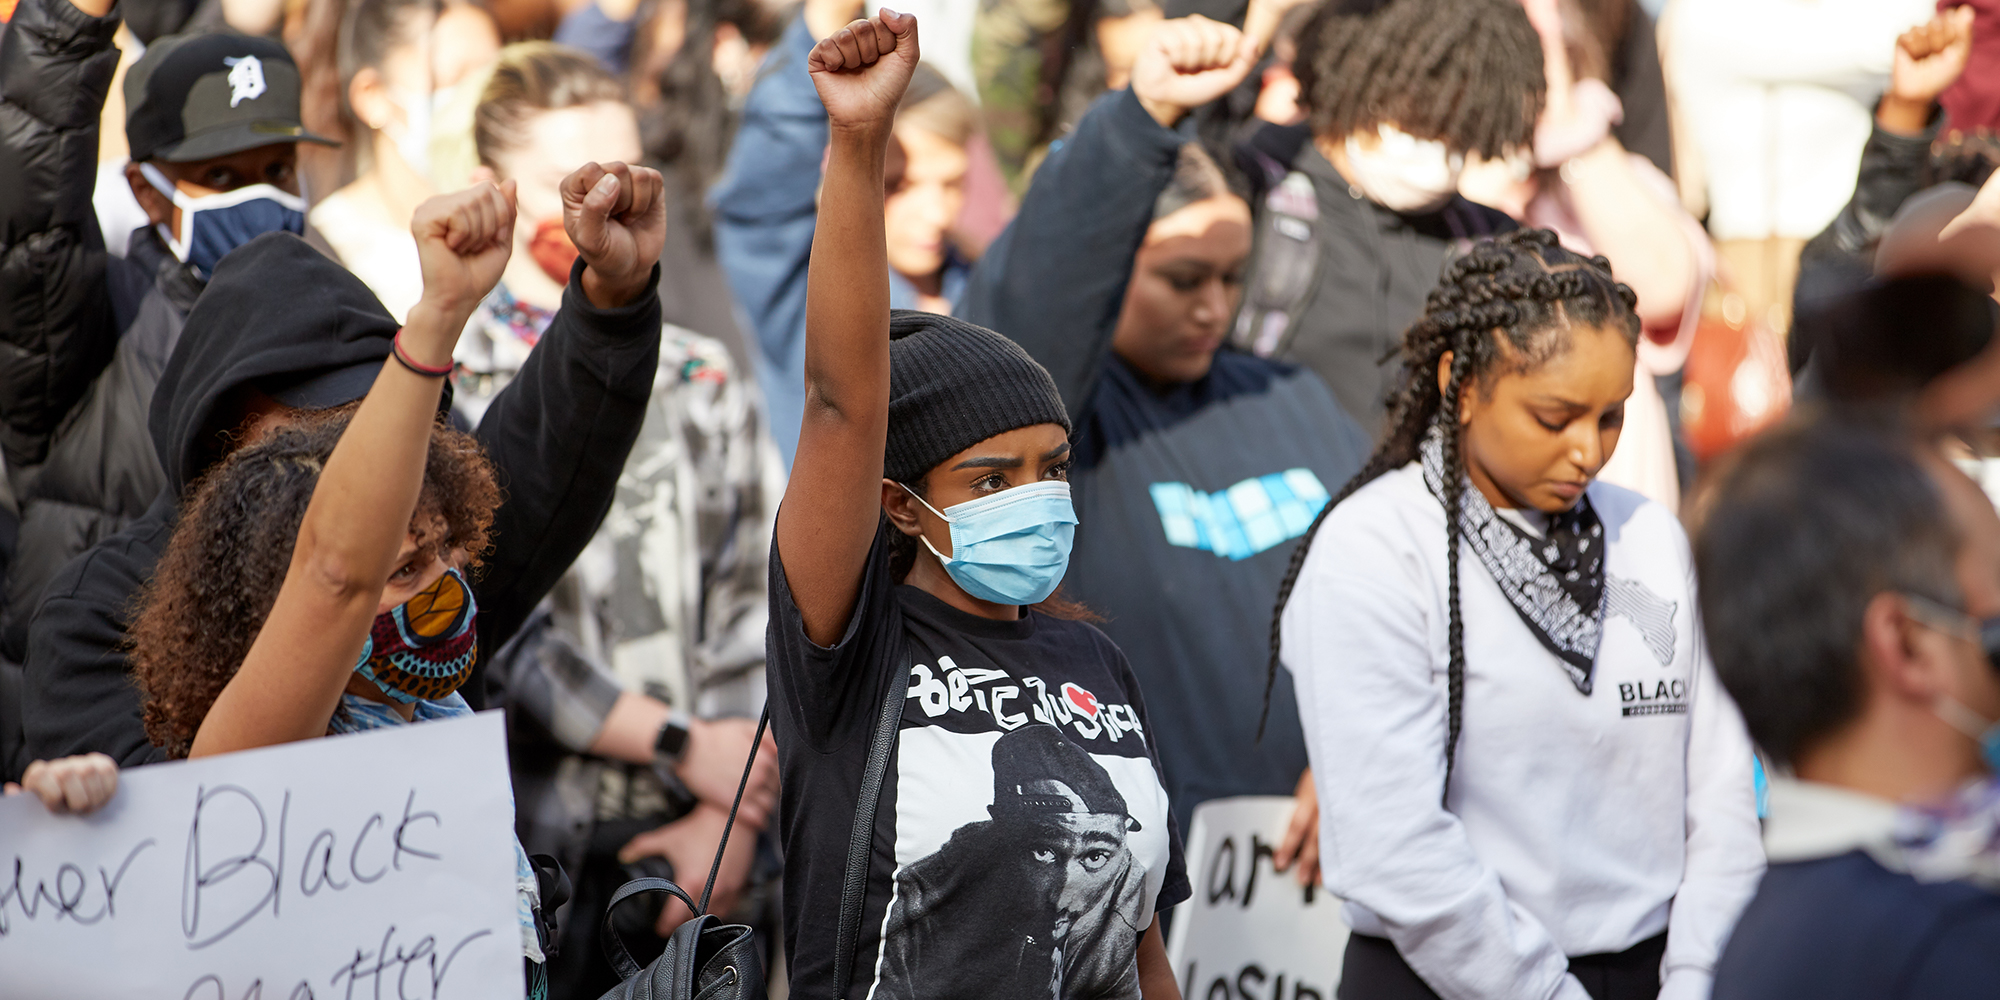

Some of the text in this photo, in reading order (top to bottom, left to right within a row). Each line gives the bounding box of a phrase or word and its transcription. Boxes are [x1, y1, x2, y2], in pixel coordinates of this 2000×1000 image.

[223, 54, 267, 109] D
[1619, 679, 1686, 701] BLAC
[182, 785, 441, 951] Black
